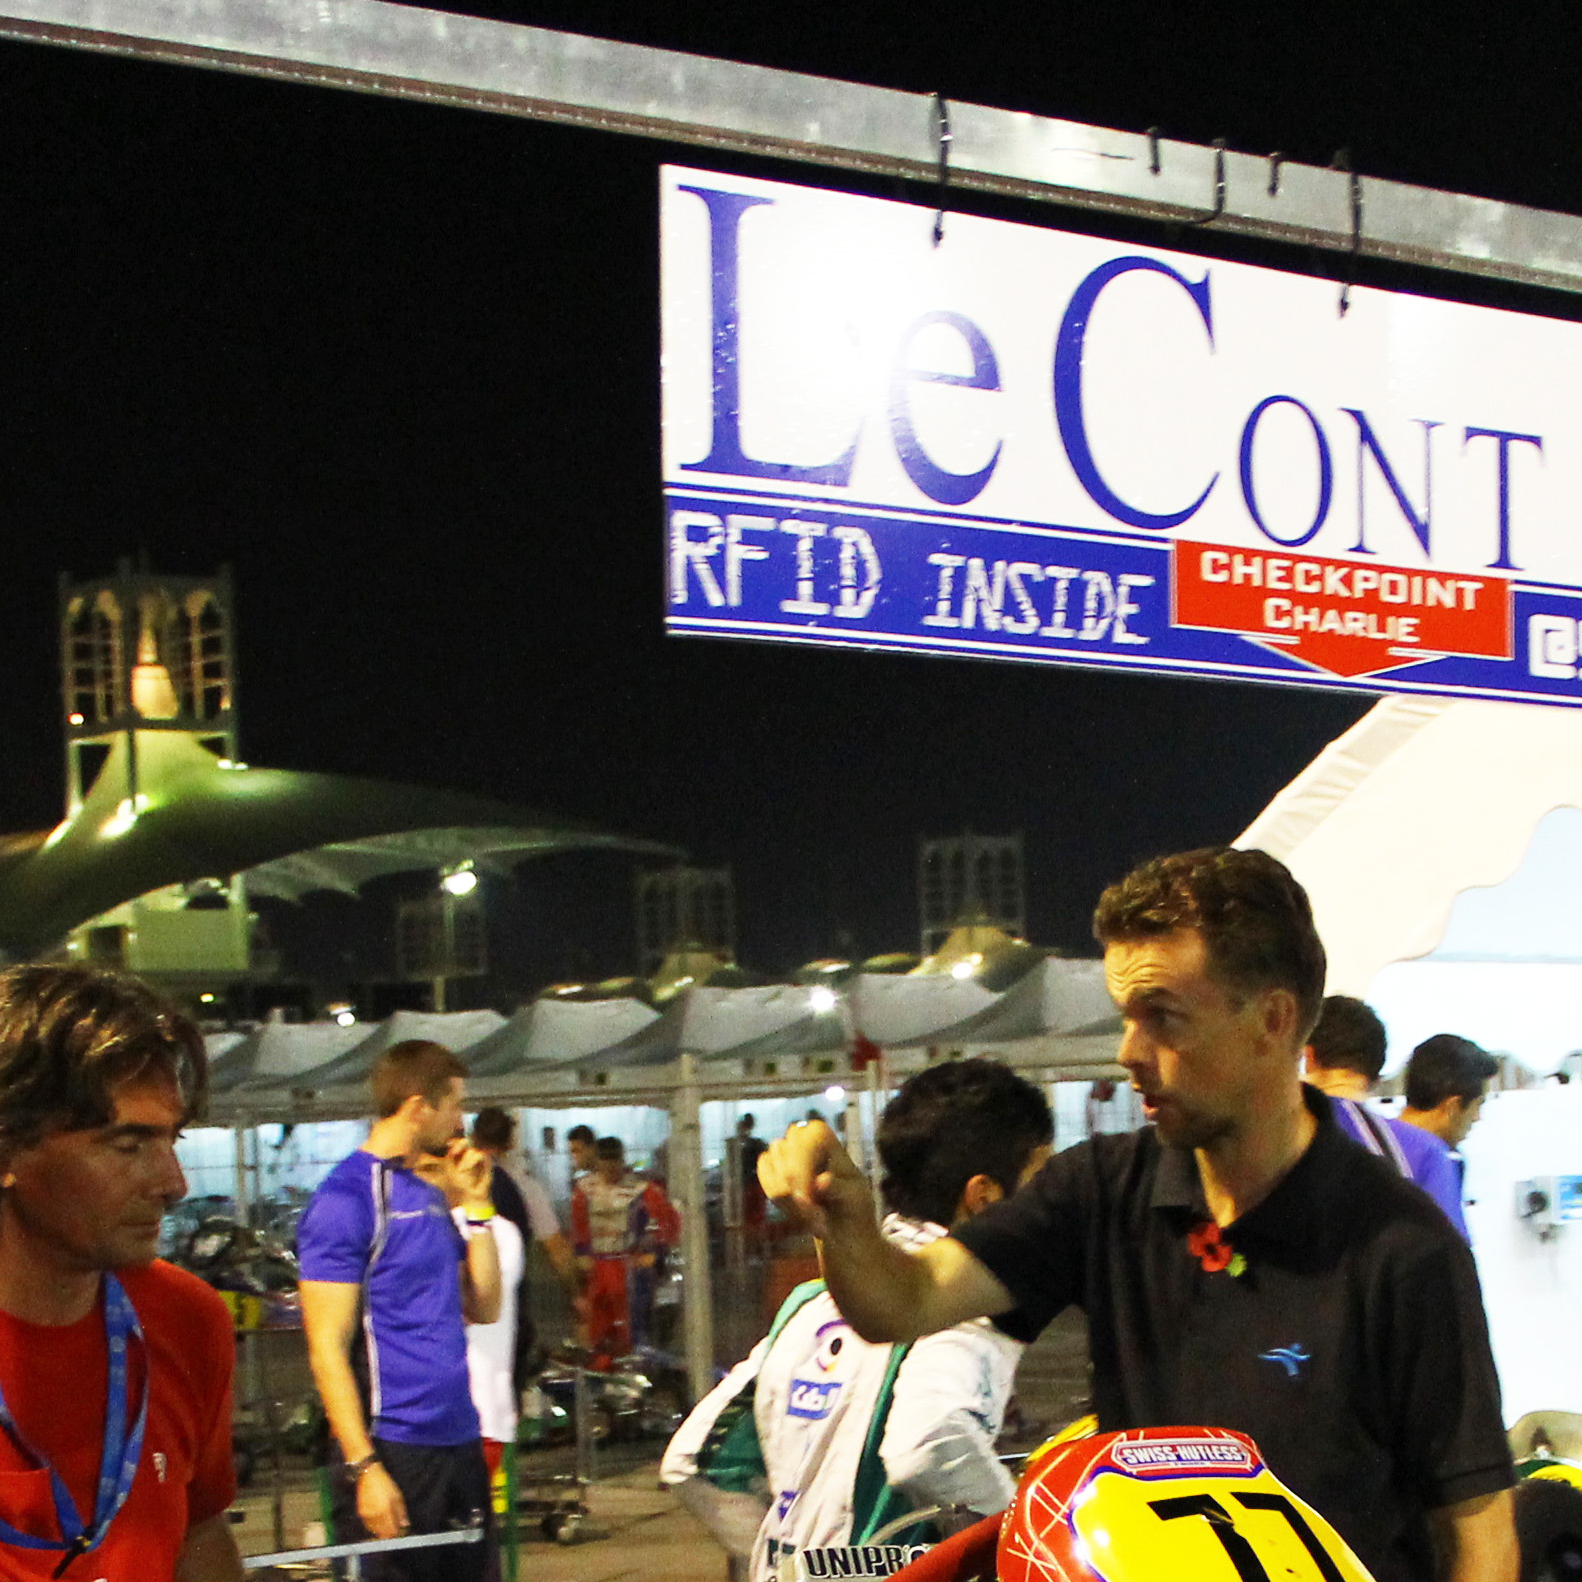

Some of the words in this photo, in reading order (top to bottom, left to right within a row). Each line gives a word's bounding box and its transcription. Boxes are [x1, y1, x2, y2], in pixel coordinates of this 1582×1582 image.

[670, 510, 882, 619] RFID
[922, 551, 1156, 645] INSIDE
[1199, 550, 1483, 612] CHECKPOINT
[1263, 597, 1421, 643] CHARLIE
